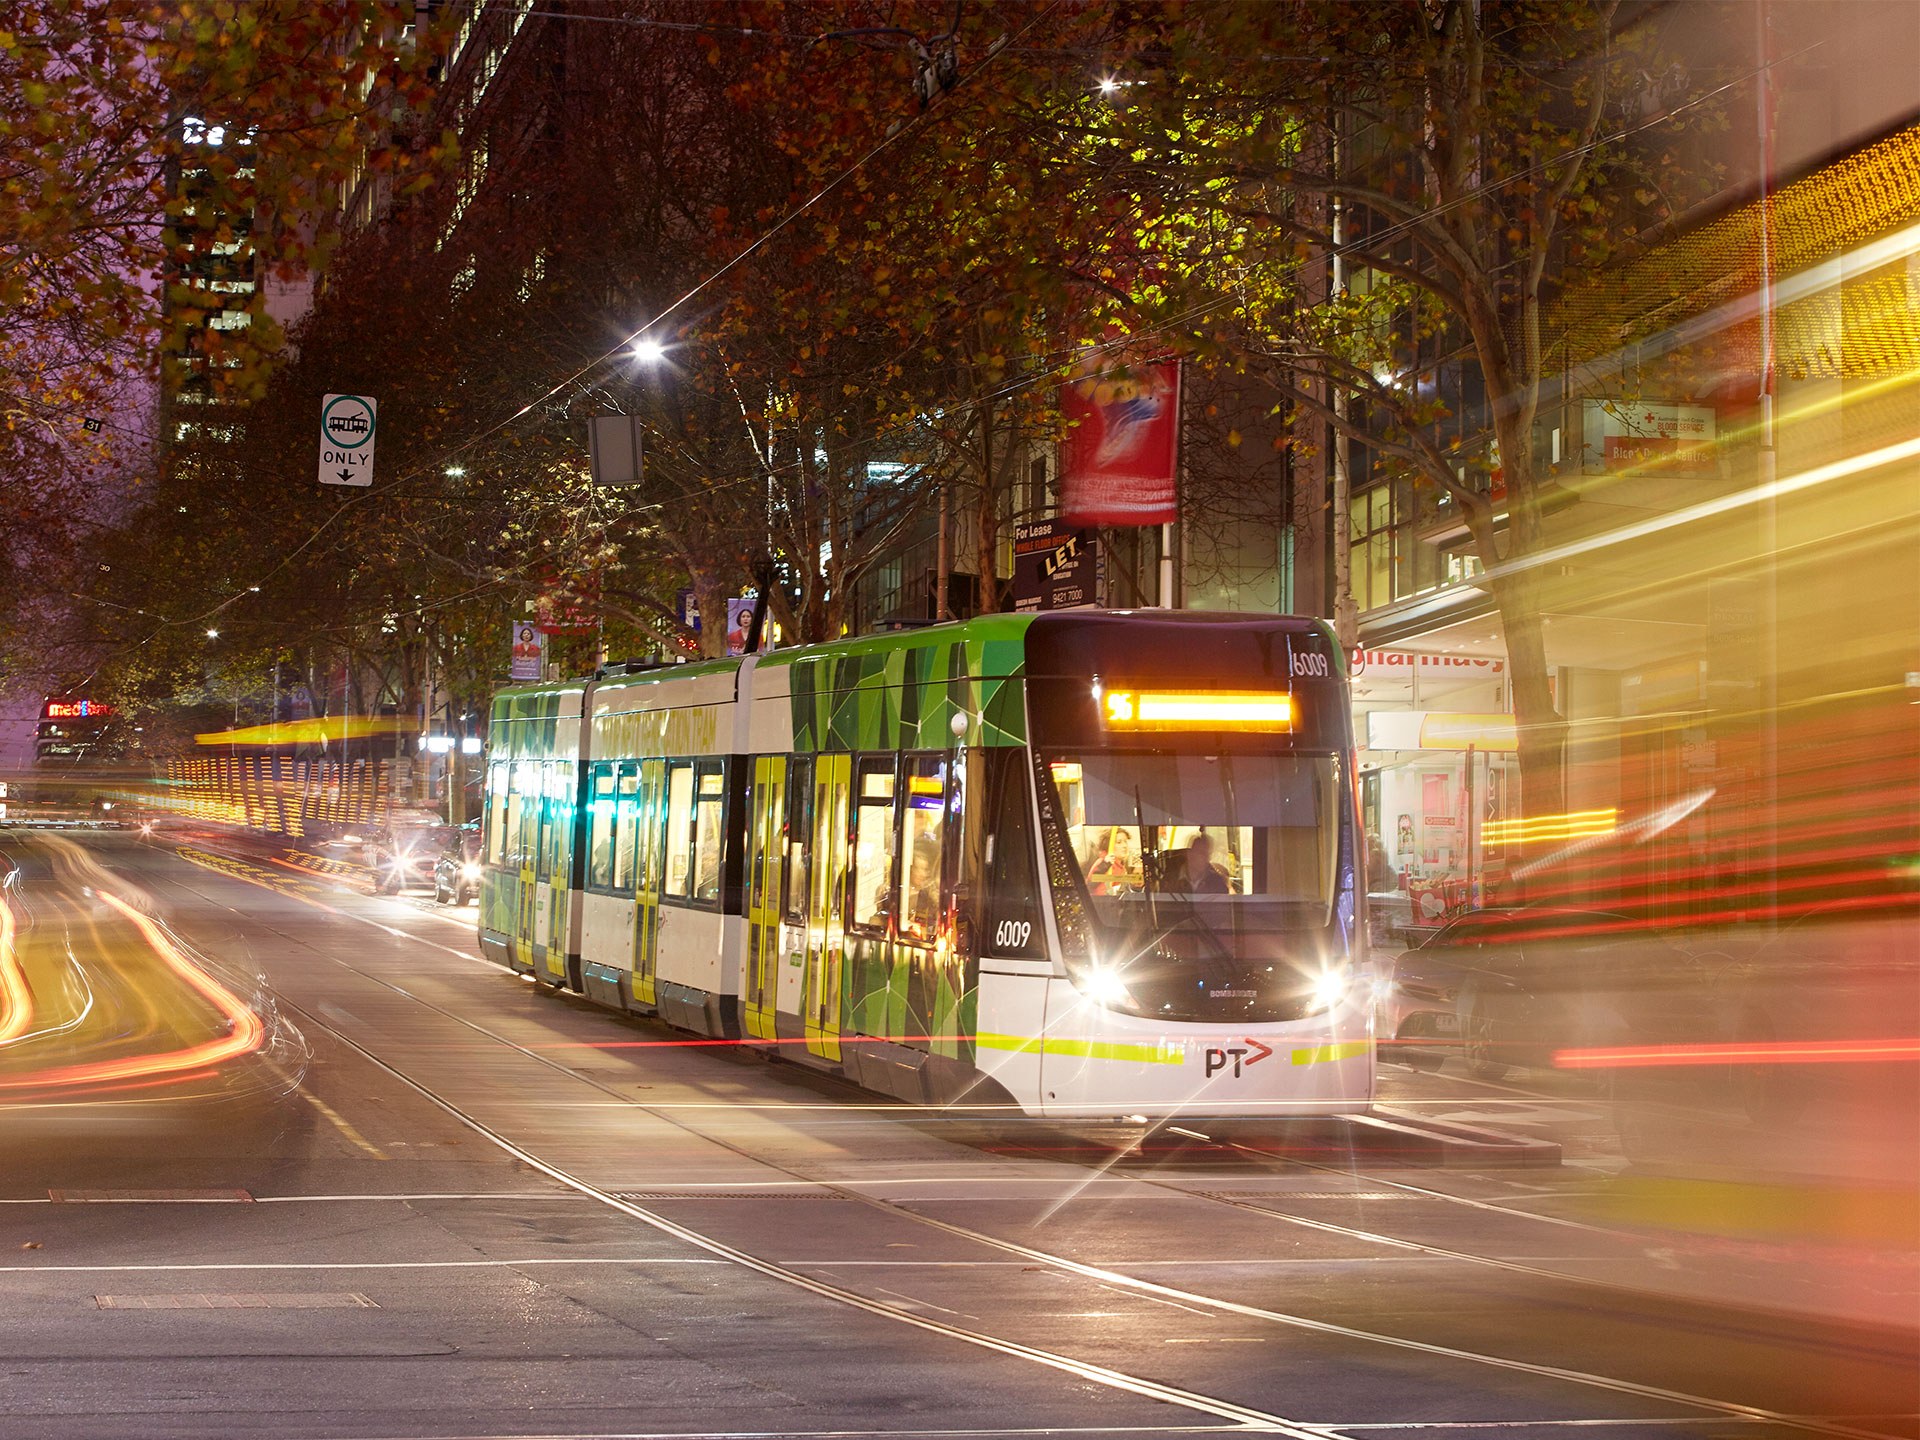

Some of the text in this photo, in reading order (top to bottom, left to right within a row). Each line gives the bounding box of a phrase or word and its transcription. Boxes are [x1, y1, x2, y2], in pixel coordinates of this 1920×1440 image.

[87, 420, 99, 431] 31
[1657, 422, 1678, 431] BLOOD
[323, 450, 370, 466] ONLY
[1613, 446, 1639, 460] Bloo
[1015, 524, 1053, 540] For Lease
[1045, 536, 1077, 576] LET
[1052, 591, 1067, 604] 9421
[1068, 589, 1083, 601] 7000
[1293, 652, 1328, 677] 6009
[996, 920, 1031, 948] 6009
